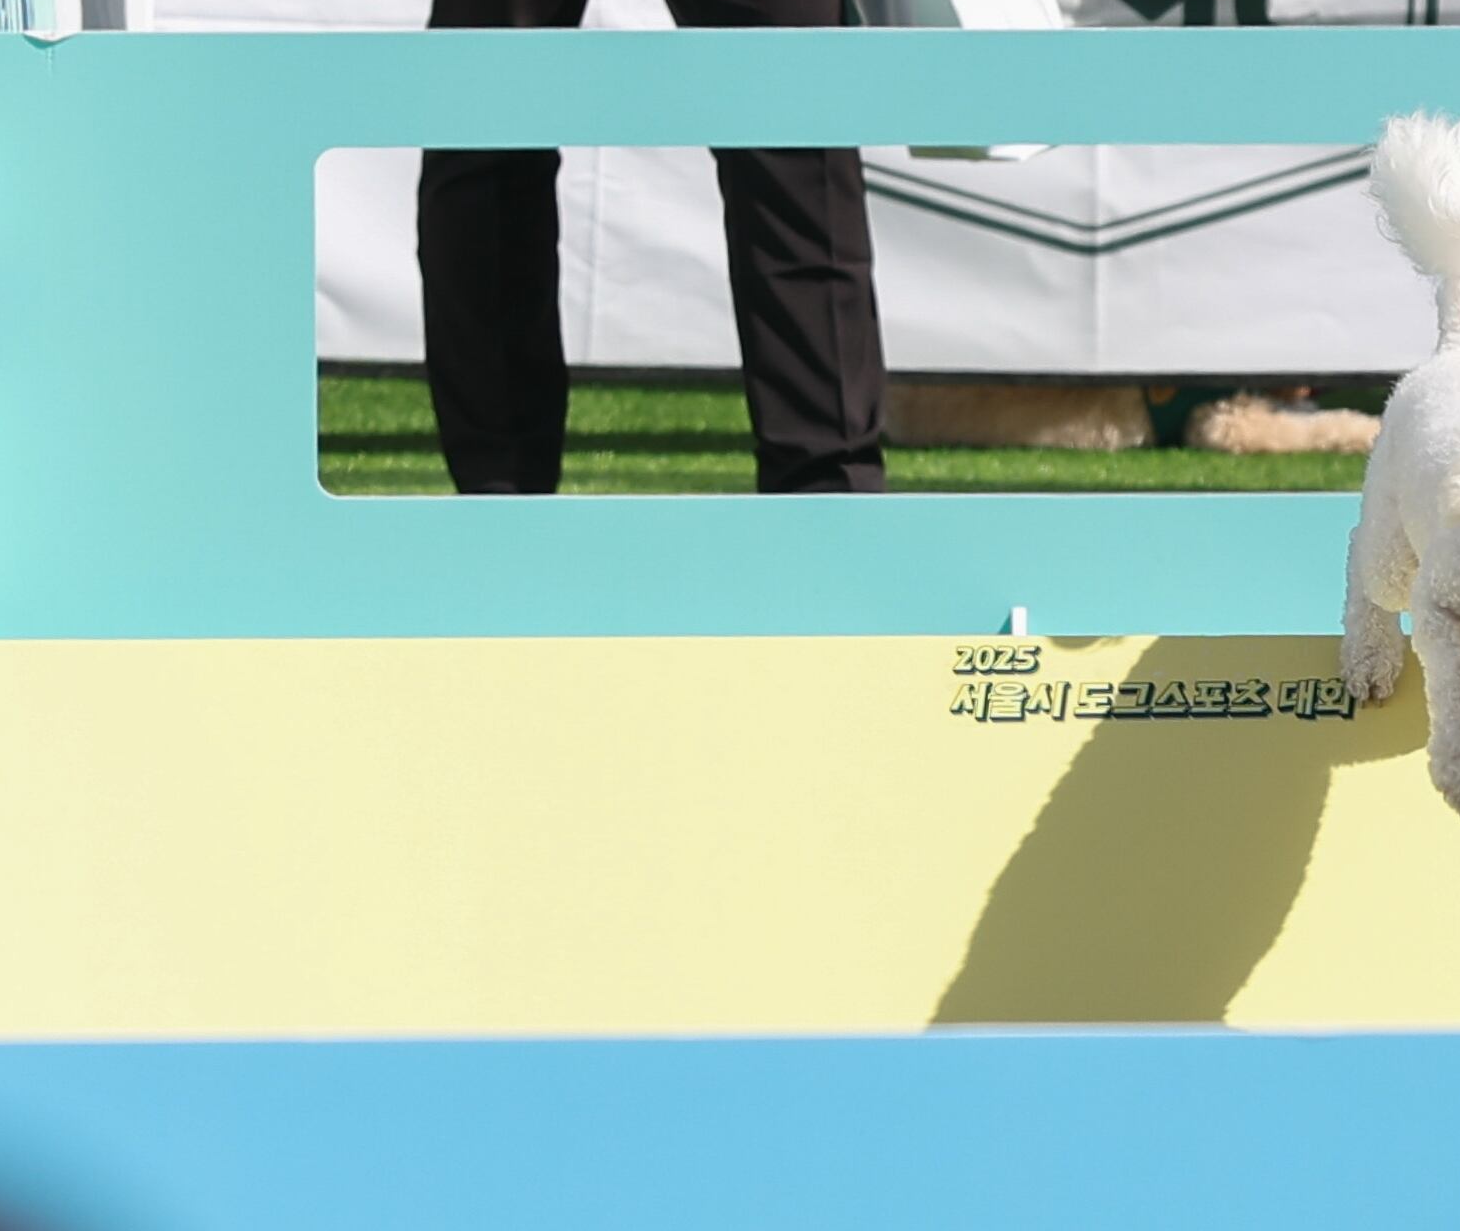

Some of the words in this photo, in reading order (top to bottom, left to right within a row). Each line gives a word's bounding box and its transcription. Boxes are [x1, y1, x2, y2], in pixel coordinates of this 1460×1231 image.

[952, 645, 1041, 674] 2025
[949, 680, 1071, 721] 서울시
[1072, 677, 1271, 720] 도그스포츠
[1276, 676, 1357, 720] 대회
